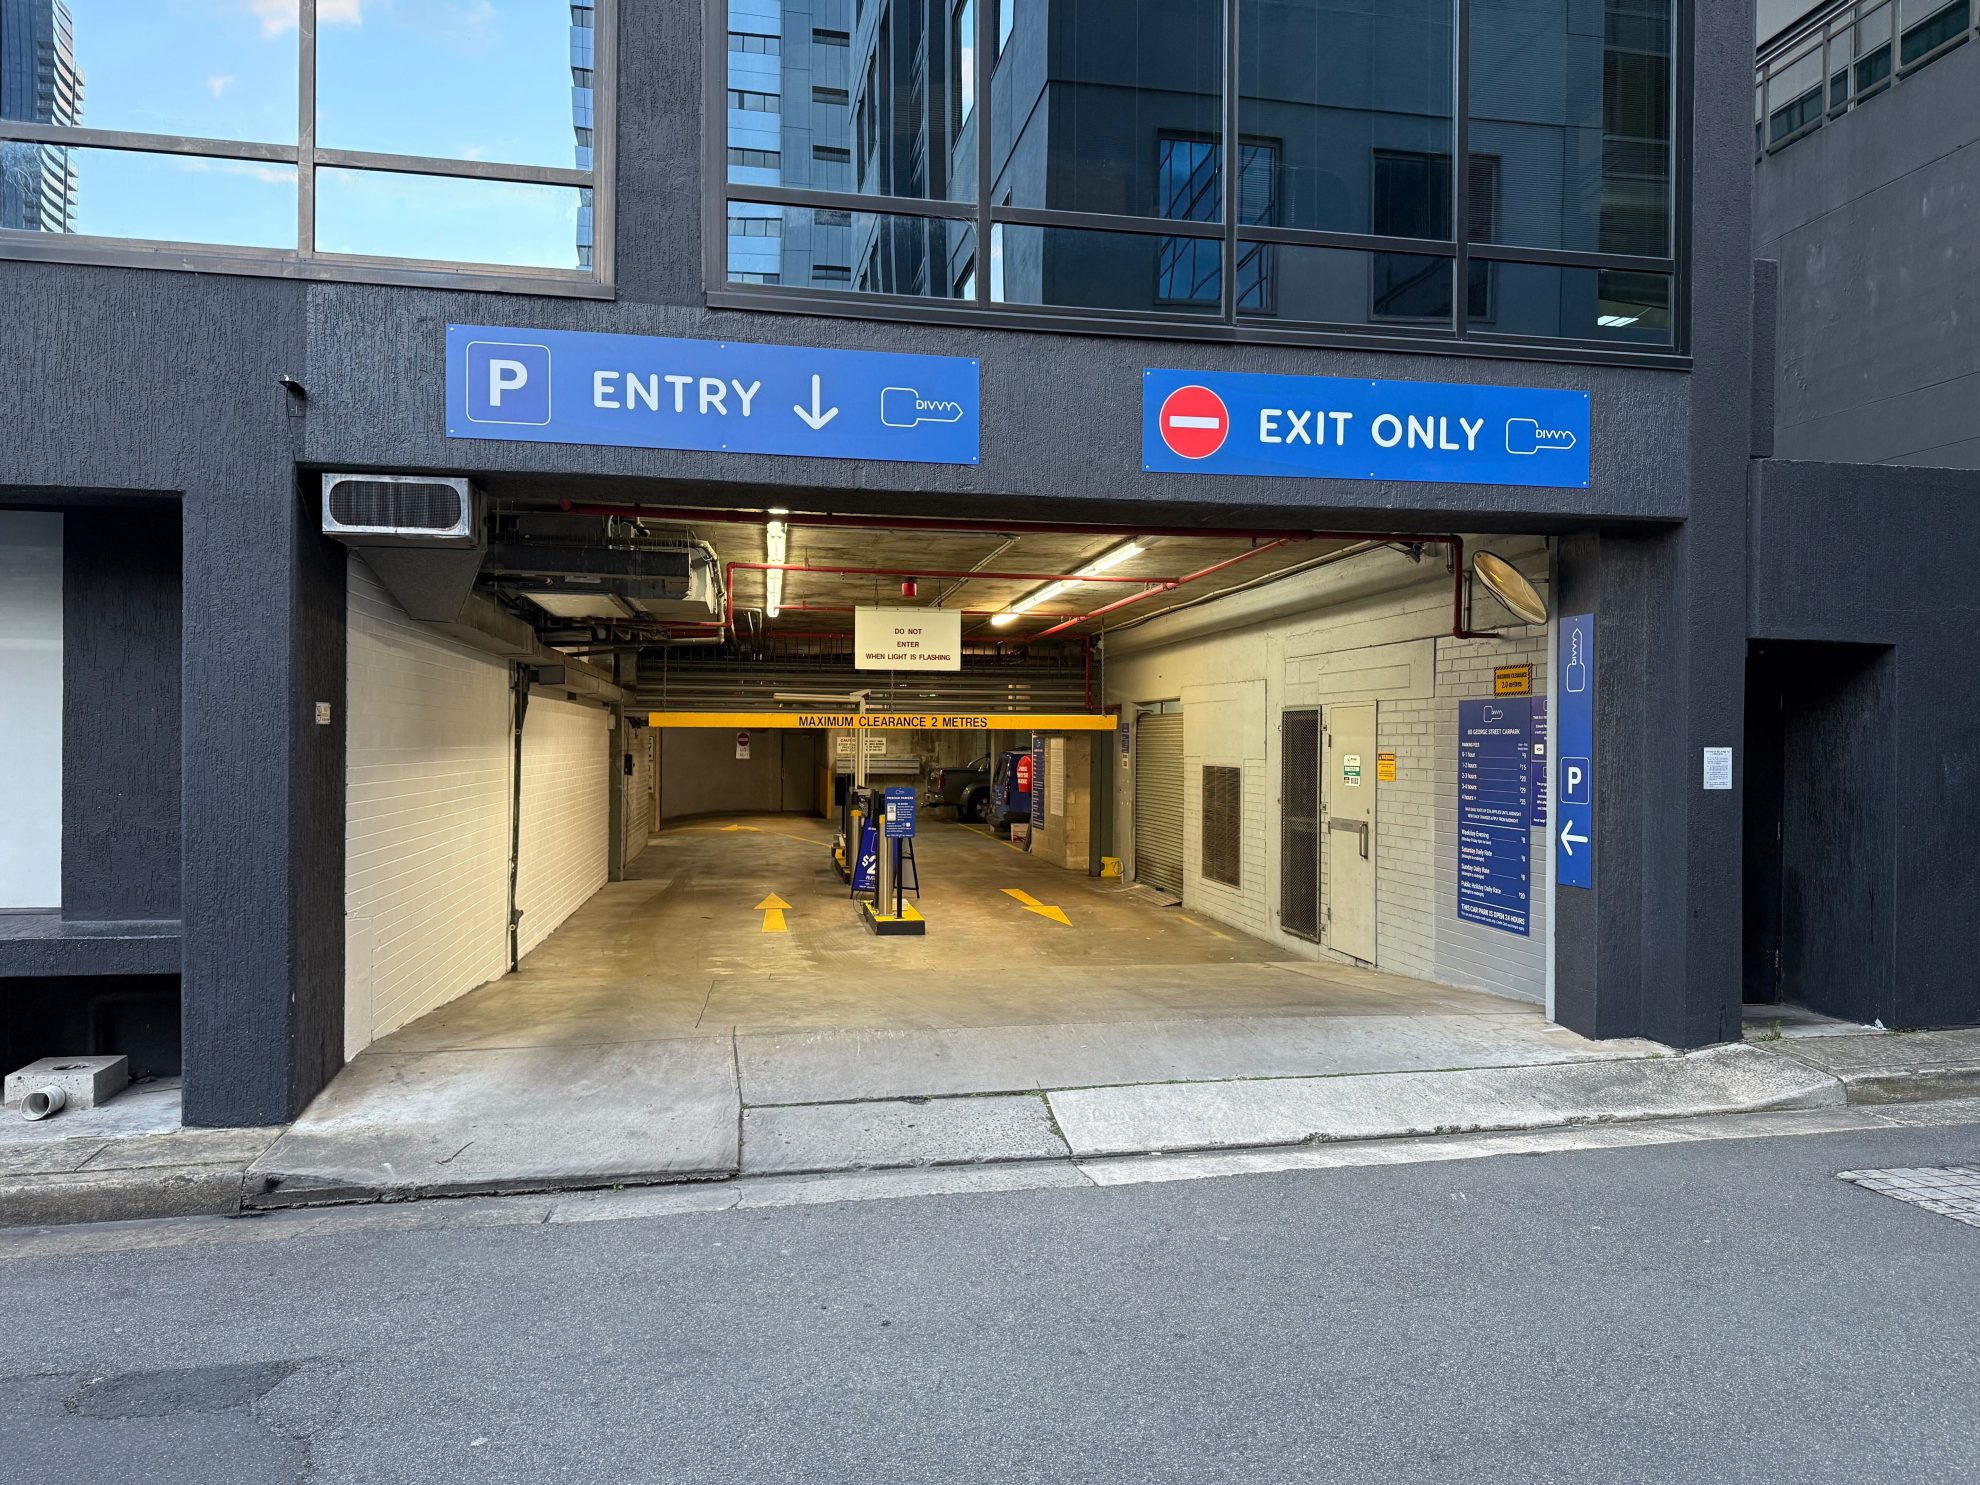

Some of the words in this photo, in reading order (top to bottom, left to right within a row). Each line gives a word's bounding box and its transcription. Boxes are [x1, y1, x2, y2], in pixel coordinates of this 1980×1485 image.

[490, 359, 527, 407] P
[594, 371, 761, 417] ENTRY
[916, 400, 953, 412] DIVVY
[1259, 408, 1353, 446] EXIT
[1371, 413, 1484, 451] ONLY
[1536, 429, 1567, 440] DIVVY
[798, 716, 854, 727] MAXIMUM
[859, 716, 926, 728] CLEARANCE
[931, 716, 938, 728] 2
[942, 717, 988, 728] METRES
[1488, 728, 1502, 736] STREET
[1568, 766, 1582, 794] P
[1476, 831, 1490, 840] Evening
[1476, 848, 1484, 857] Daily
[1473, 865, 1482, 874] Daily
[1482, 867, 1490, 875] Rate
[1472, 883, 1484, 892] Holiday
[1484, 885, 1493, 894] Daily
[1493, 887, 1502, 895] Rate
[1470, 905, 1478, 913] CAR
[1478, 908, 1489, 916] PARK
[1494, 911, 1505, 920] OPEN
[1510, 915, 1526, 926] HOURS
